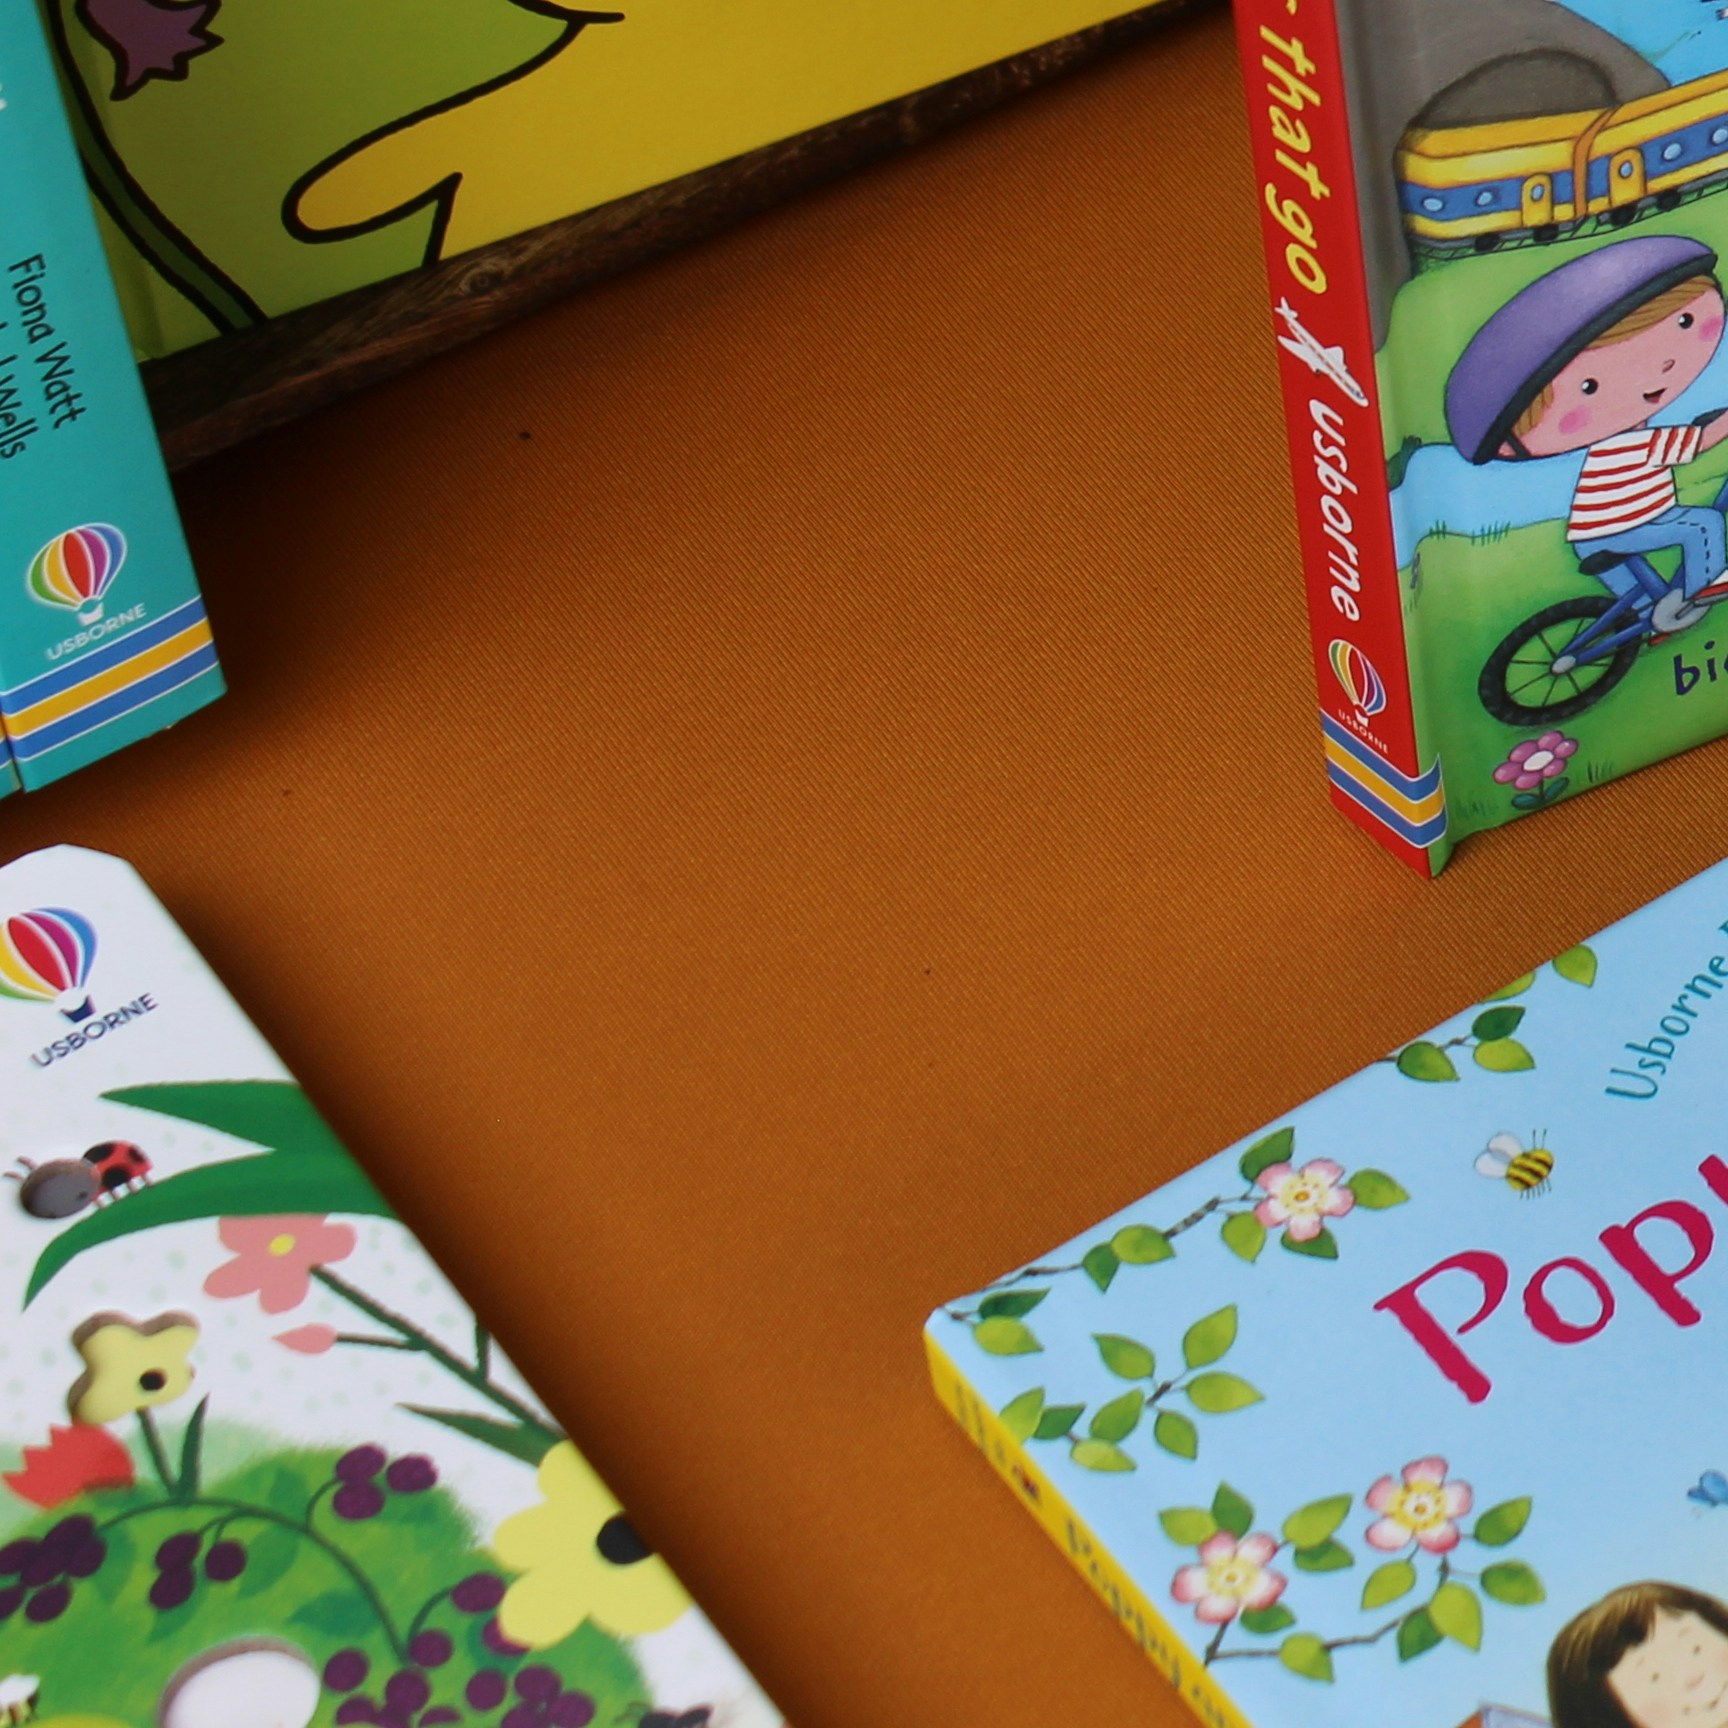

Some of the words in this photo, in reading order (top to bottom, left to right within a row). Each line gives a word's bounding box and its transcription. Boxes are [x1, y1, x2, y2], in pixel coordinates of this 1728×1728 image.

[1259, 25, 1331, 201] that
[1264, 182, 1329, 295] go
[8, 251, 56, 346] Fiona
[34, 340, 88, 430] Watt
[1308, 398, 1361, 622] usborne
[45, 602, 148, 662] USBORNE
[1337, 708, 1390, 755] USBORNE
[30, 991, 159, 1070] USBORNE
